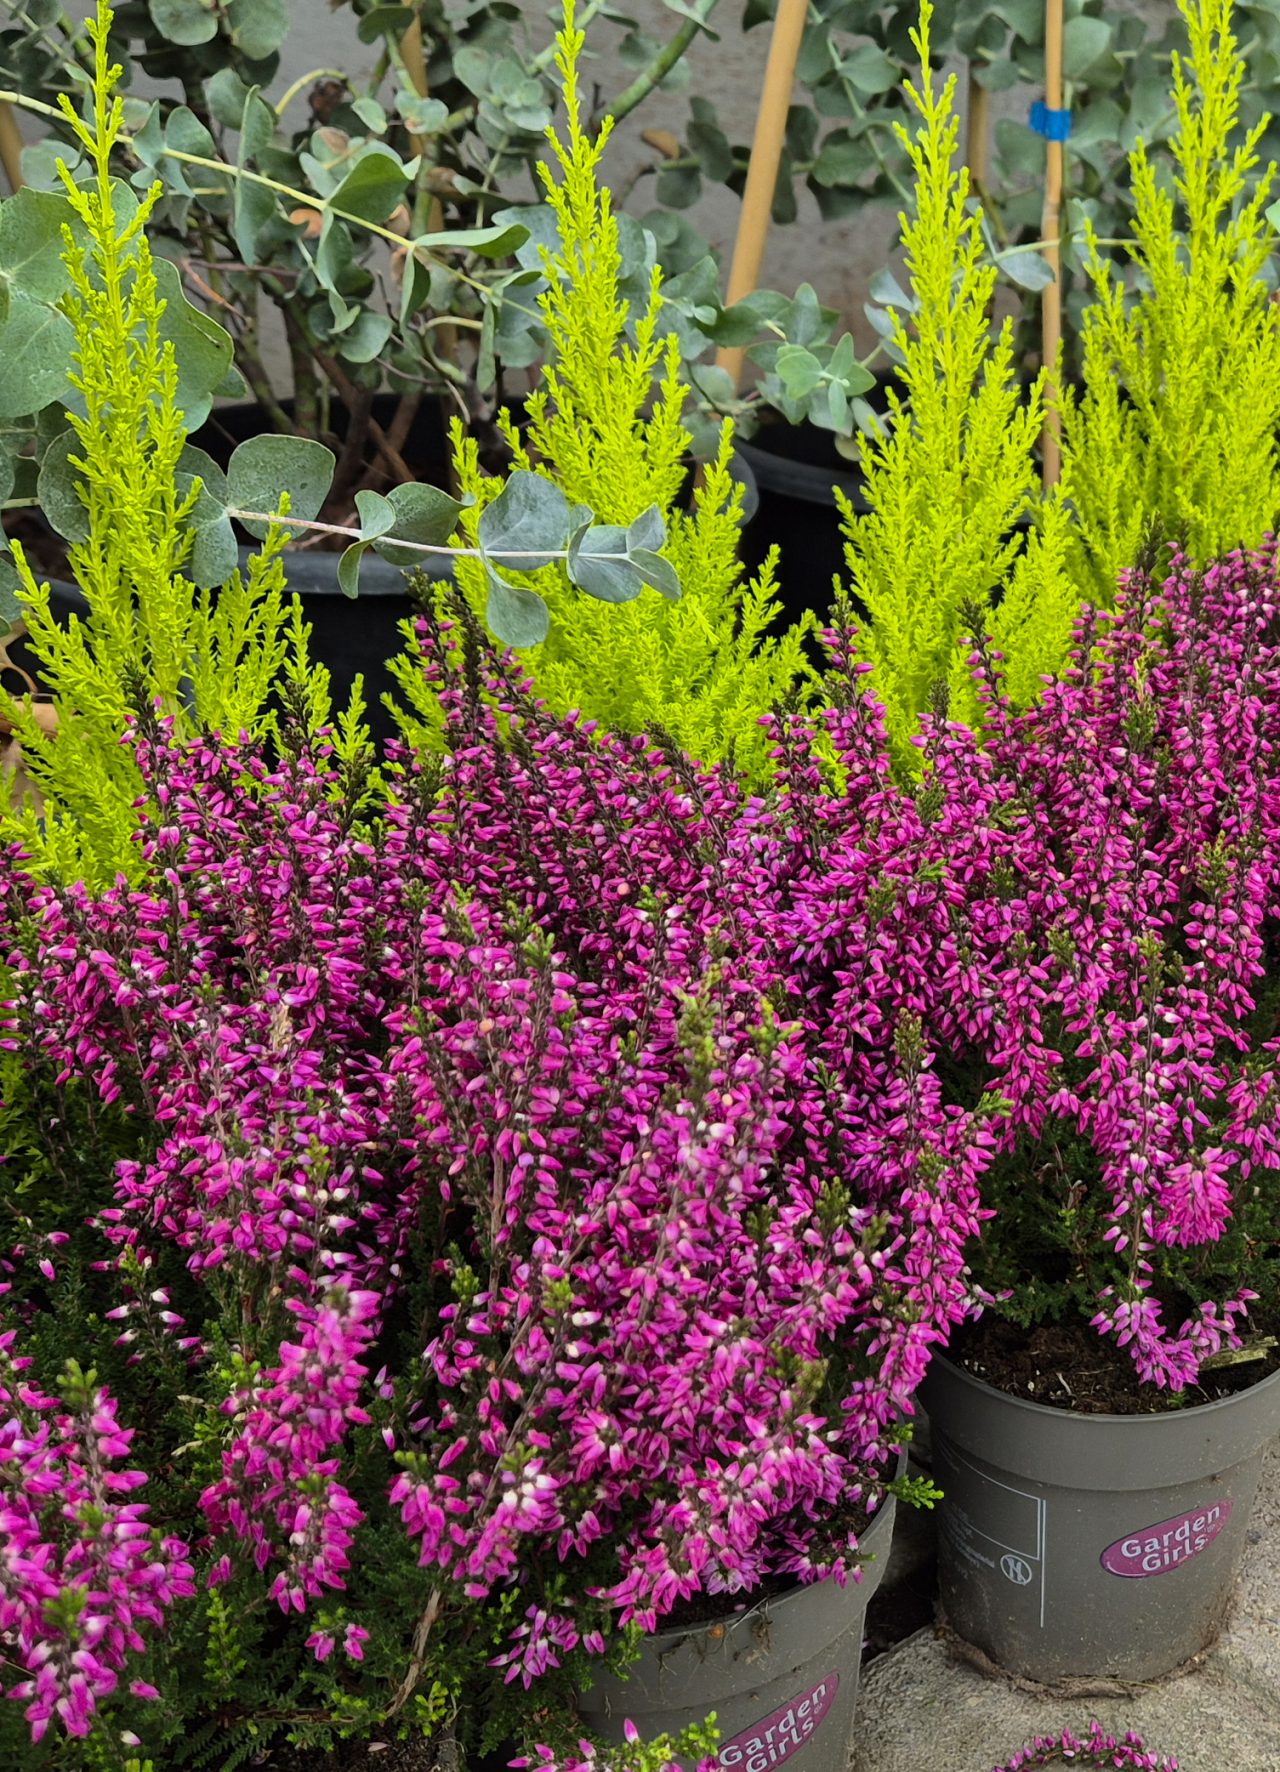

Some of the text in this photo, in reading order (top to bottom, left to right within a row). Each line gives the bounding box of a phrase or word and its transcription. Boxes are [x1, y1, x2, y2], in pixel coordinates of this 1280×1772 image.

[1120, 1505, 1220, 1558] Garden
[1142, 1533, 1208, 1572] Girls
[719, 1683, 826, 1766] Garden
[745, 1717, 814, 1772] Girls
